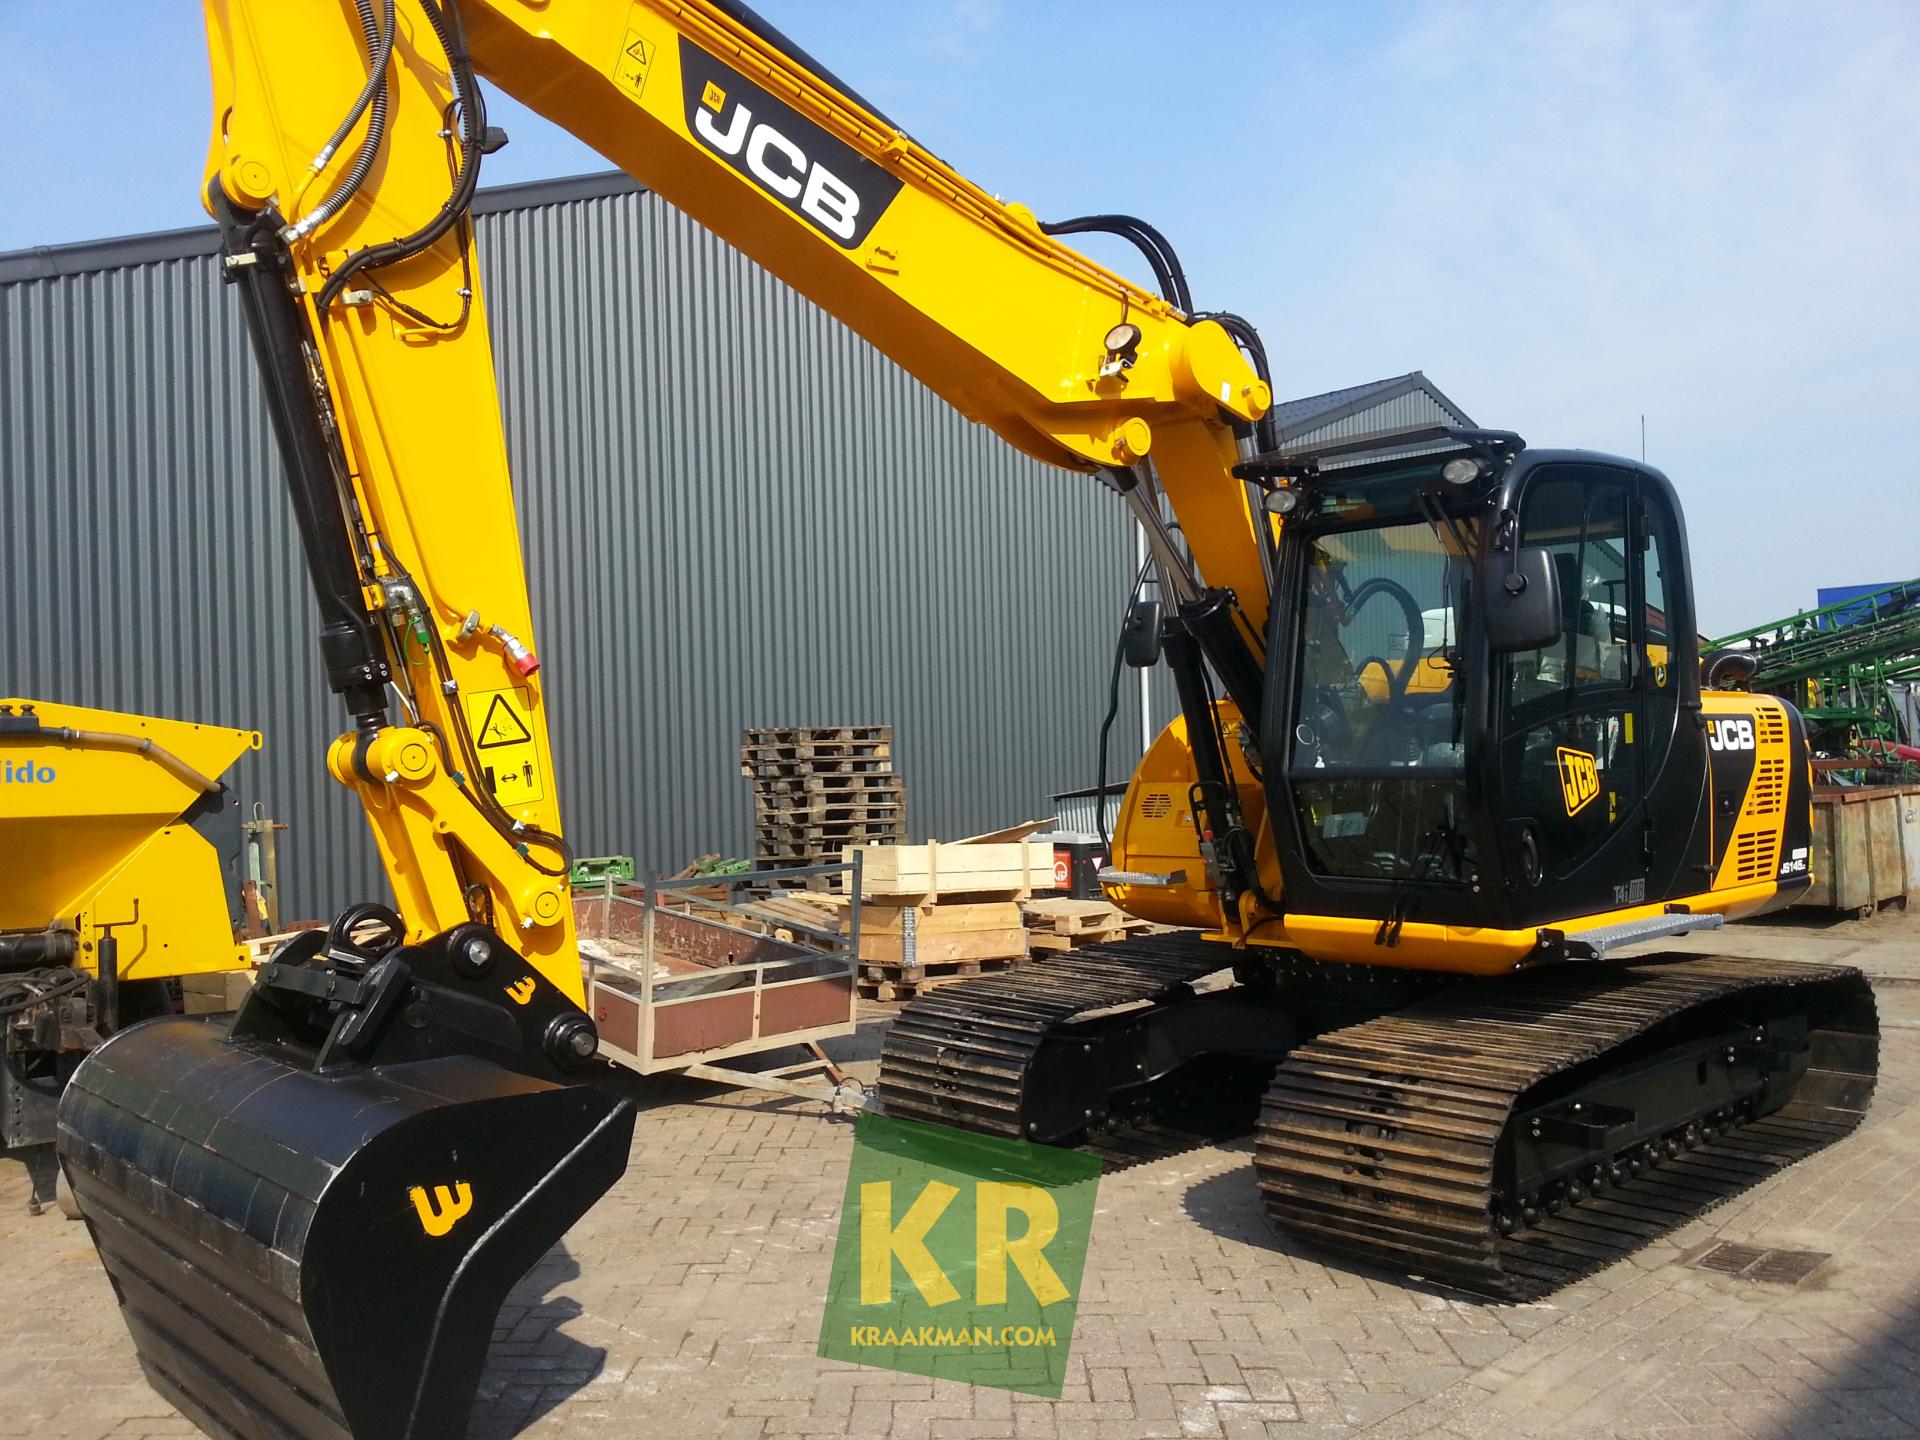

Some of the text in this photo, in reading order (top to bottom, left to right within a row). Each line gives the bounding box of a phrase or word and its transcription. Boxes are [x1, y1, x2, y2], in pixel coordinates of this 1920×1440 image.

[695, 103, 860, 240] JCB
[1709, 719, 1755, 751] JCB
[1564, 753, 1597, 809] JCB
